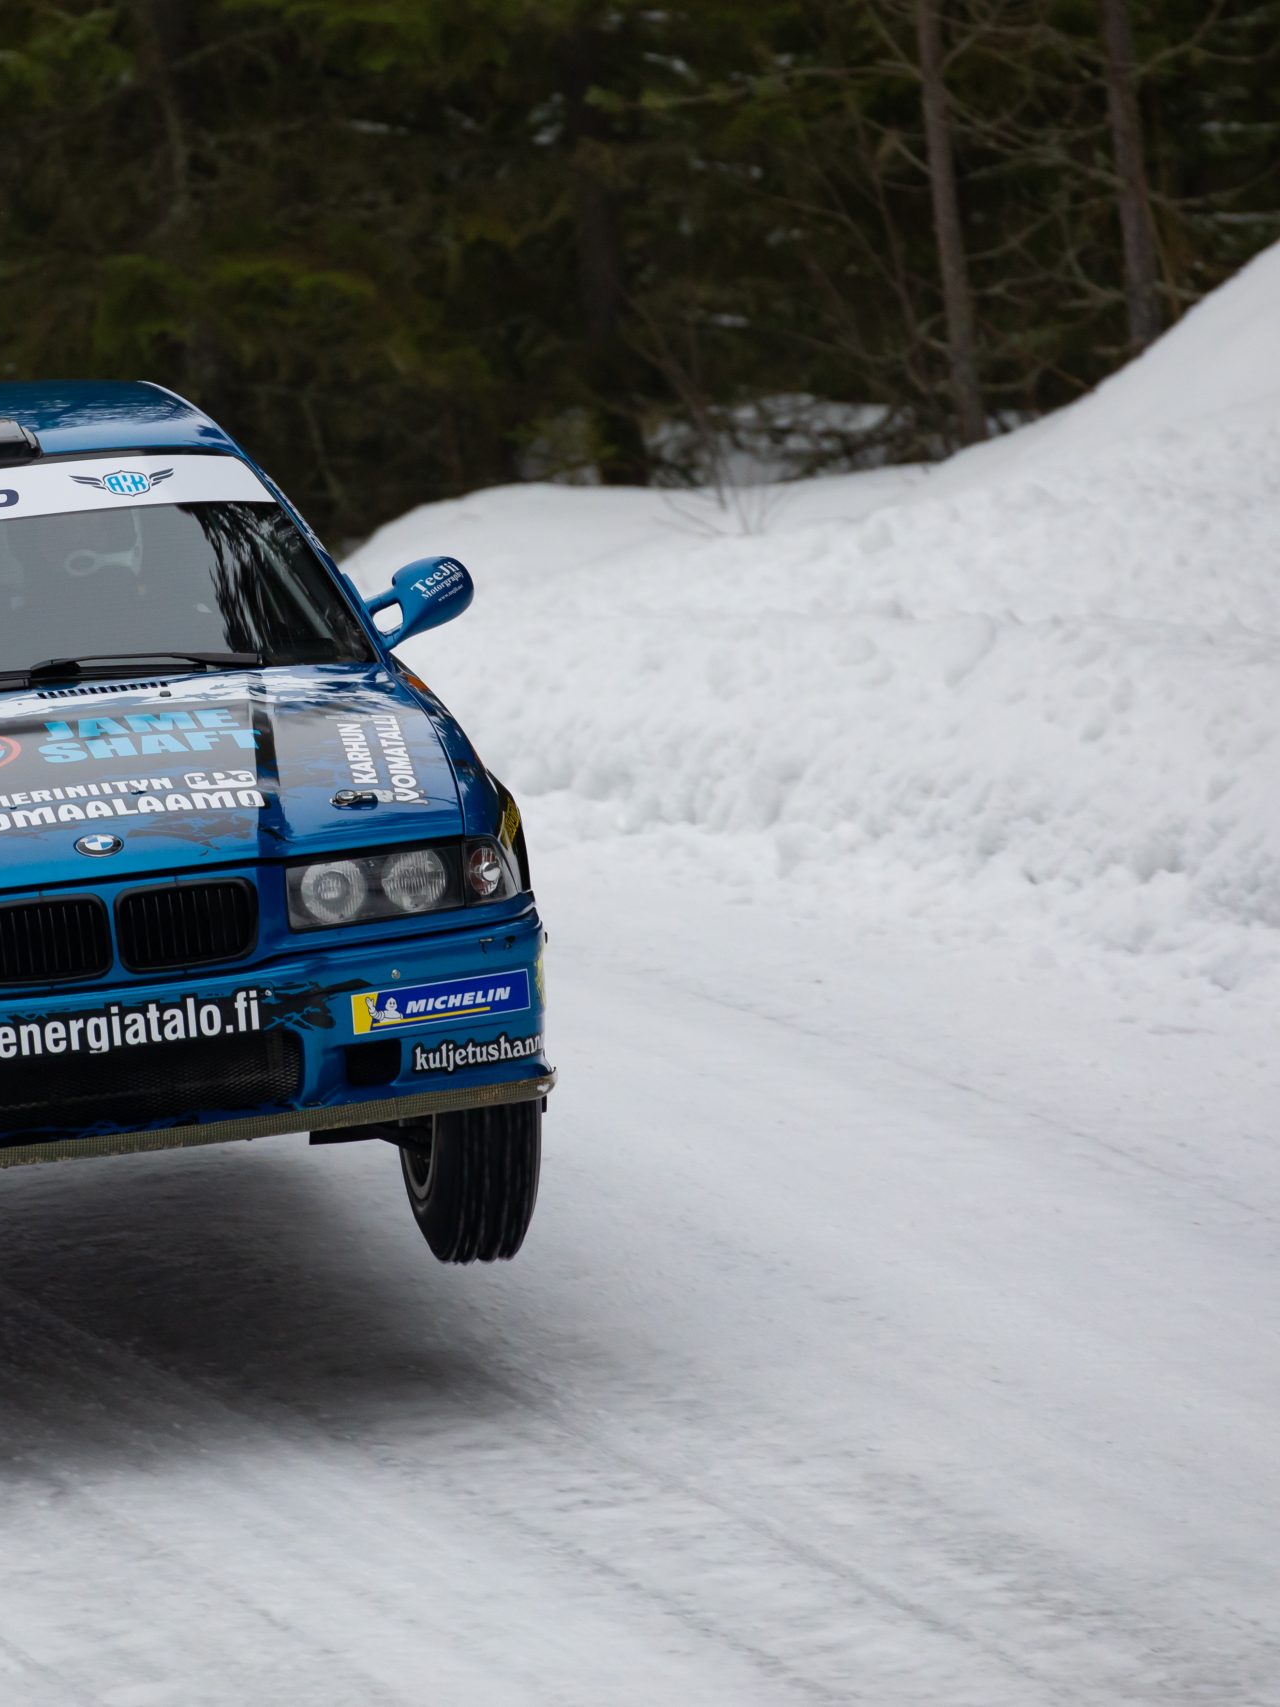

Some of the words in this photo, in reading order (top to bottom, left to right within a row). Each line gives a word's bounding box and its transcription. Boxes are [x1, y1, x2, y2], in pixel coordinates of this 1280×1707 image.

[410, 561, 460, 592] TeeJii
[421, 570, 464, 600] Motorgraphy
[43, 708, 240, 742] JAME
[38, 729, 262, 764] SHAFT
[336, 723, 379, 784] KARHUN
[370, 714, 420, 802] VOIMATALLI
[405, 986, 511, 1014] MICHELIN
